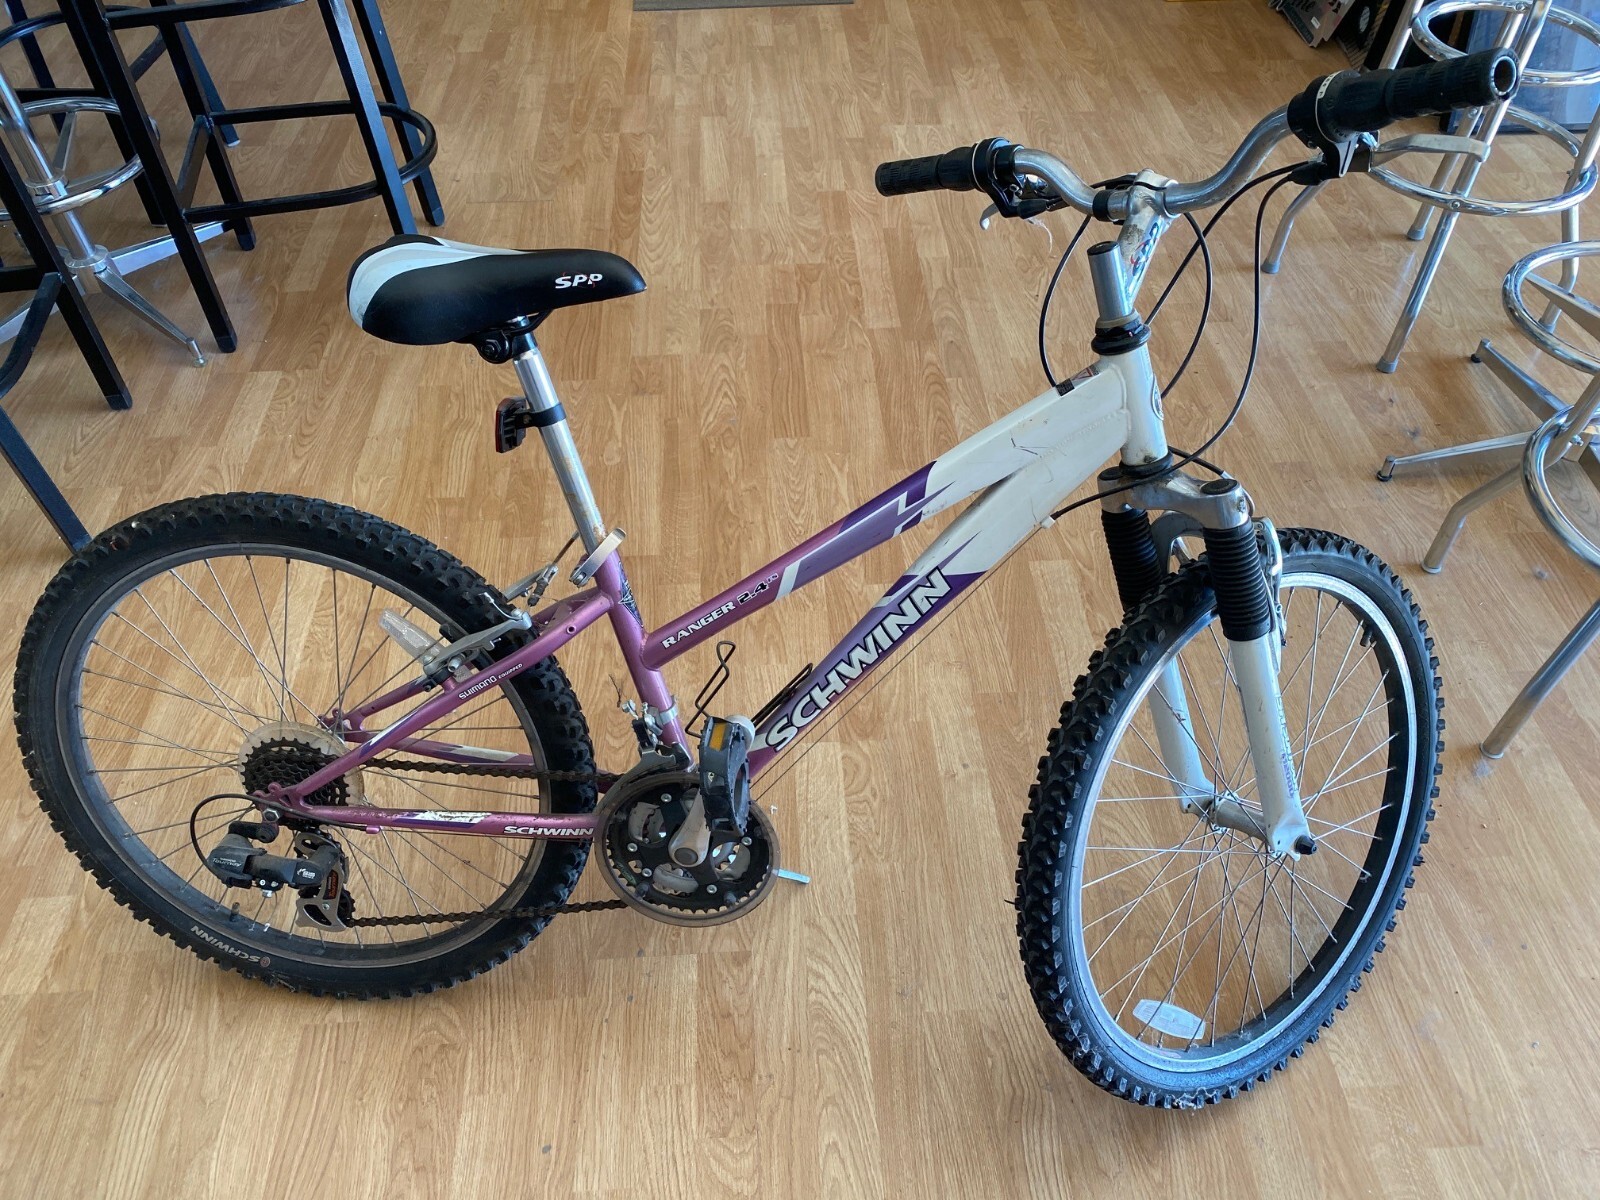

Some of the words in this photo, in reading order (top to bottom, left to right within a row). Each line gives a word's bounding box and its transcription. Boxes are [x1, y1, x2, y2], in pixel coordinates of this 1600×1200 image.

[661, 601, 736, 649] RANGER
[737, 581, 769, 605] 2.4
[765, 566, 953, 753] SCHWINN
[459, 675, 498, 700] SHIMANO
[503, 825, 594, 837] SCHWINN
[190, 925, 262, 964] SCHWINN
